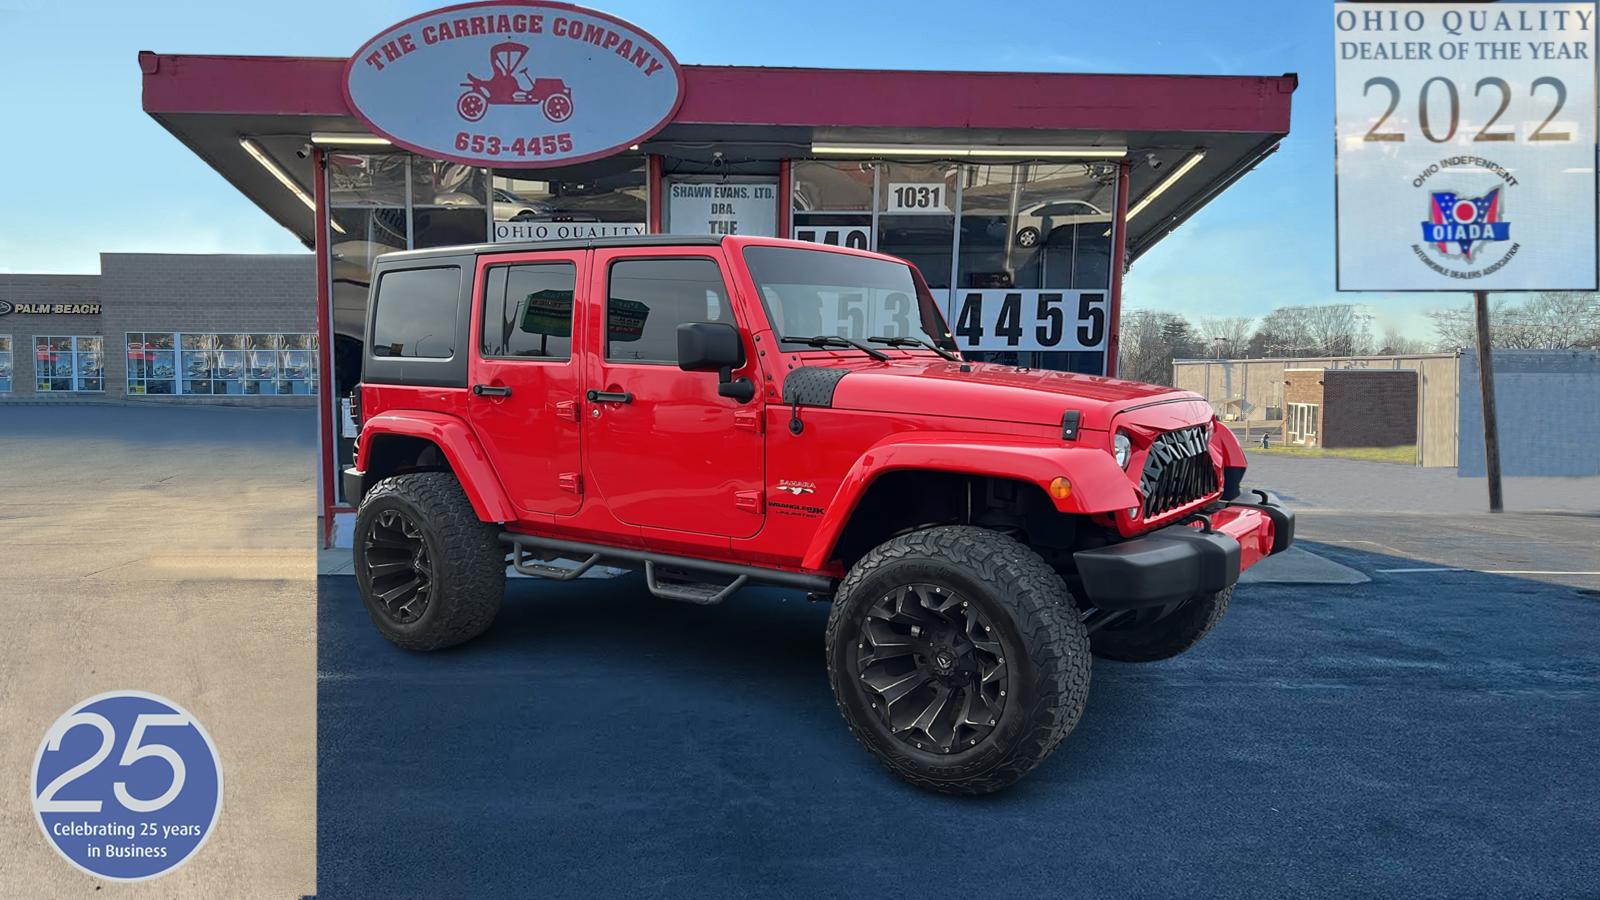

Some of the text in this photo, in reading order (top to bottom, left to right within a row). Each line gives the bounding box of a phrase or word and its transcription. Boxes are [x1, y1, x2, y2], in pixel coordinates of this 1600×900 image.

[1336, 10, 1593, 35] OHIO QUALITY
[366, 14, 664, 77] THE CARRIAGE COMPANY
[1340, 41, 1589, 60] DEALER OF THE YEAR
[1363, 76, 1570, 143] 2022
[455, 132, 574, 156] 653-4455
[1412, 156, 1519, 188] OHIO INDEPENDENT
[672, 186, 712, 199] SHAWN
[754, 187, 775, 200] LTD.
[895, 187, 940, 208] 1031
[711, 203, 736, 215] DBA.
[497, 226, 644, 239] OHIO QUALITY
[708, 220, 738, 236] THE
[1432, 224, 1495, 240] OIADA
[1411, 242, 1521, 280] AUTOMOBILE DEALERS ASSOCIATION
[15, 303, 100, 314] PALM BEACH
[956, 292, 1105, 346] 4455
